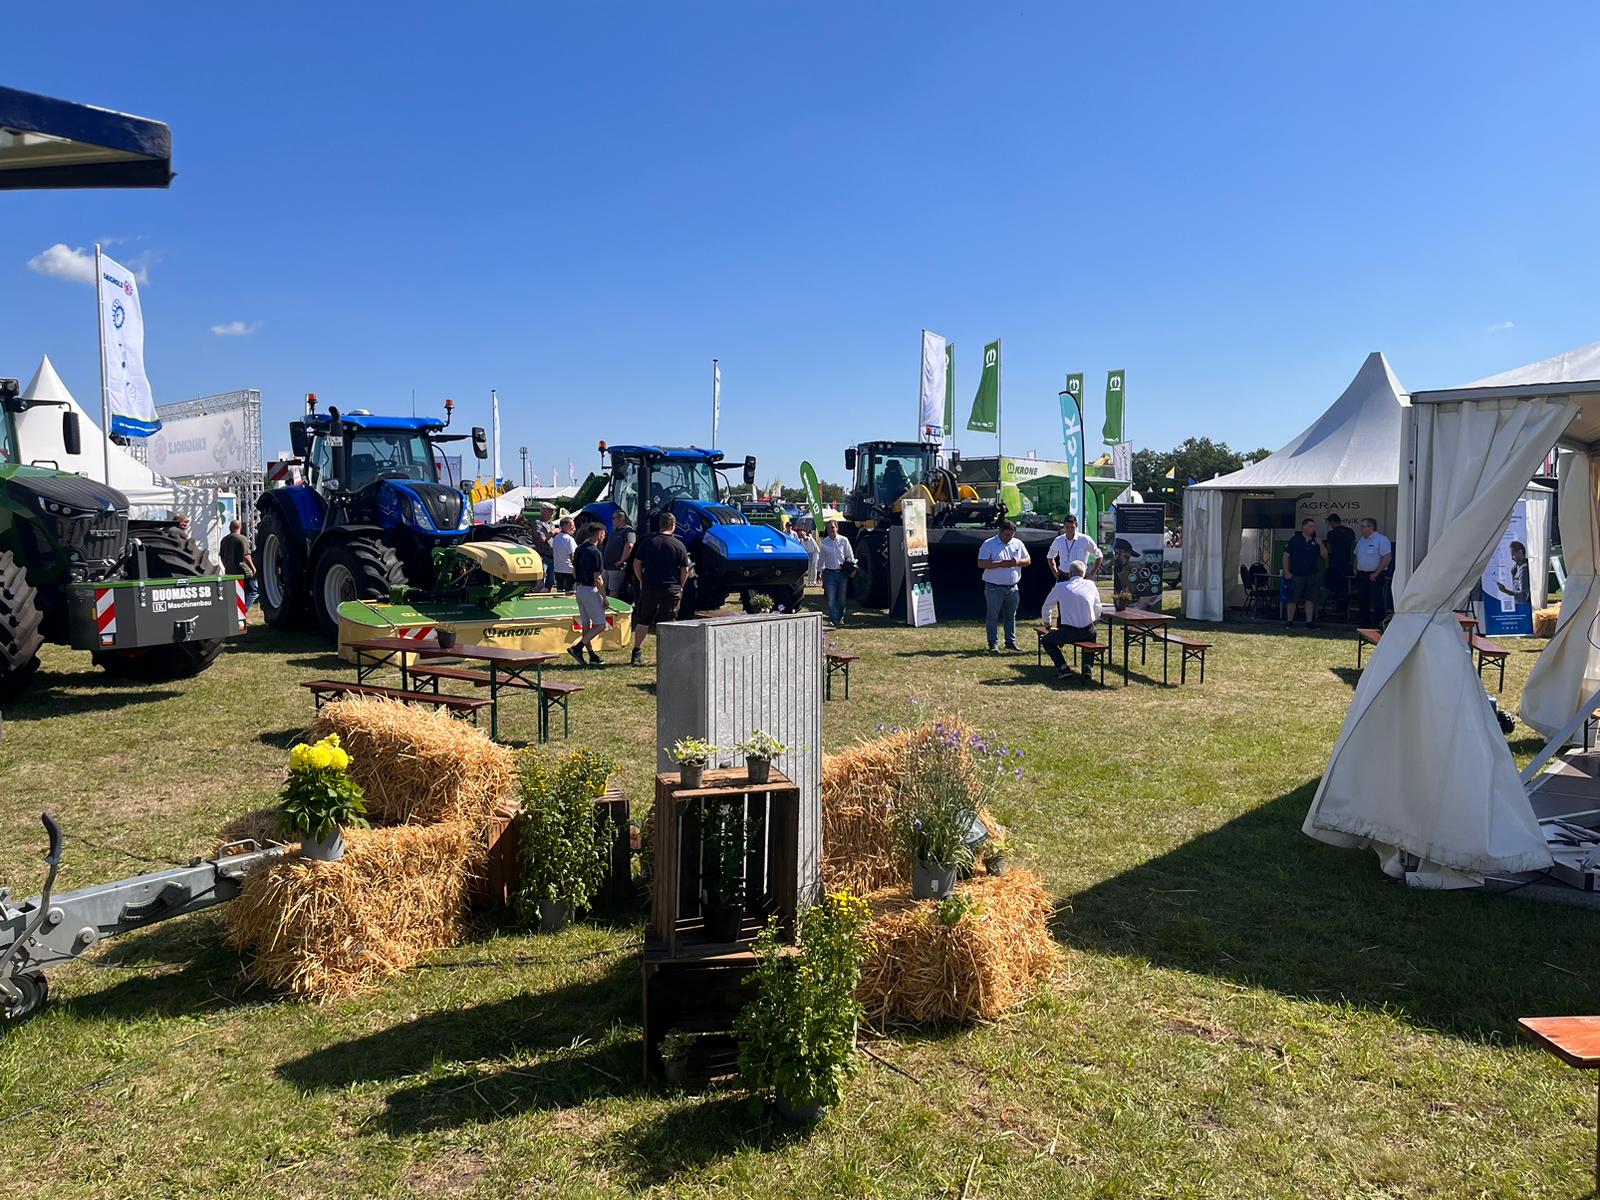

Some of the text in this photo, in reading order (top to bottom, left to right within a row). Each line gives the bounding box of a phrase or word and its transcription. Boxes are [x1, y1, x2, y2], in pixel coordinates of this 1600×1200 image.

[1015, 466, 1038, 476] KRONE
[1300, 501, 1360, 510] AGRAVIS
[152, 586, 211, 601] DUOMASS SB
[167, 600, 212, 610] Maschinenbau
[497, 627, 541, 638] KRONE
